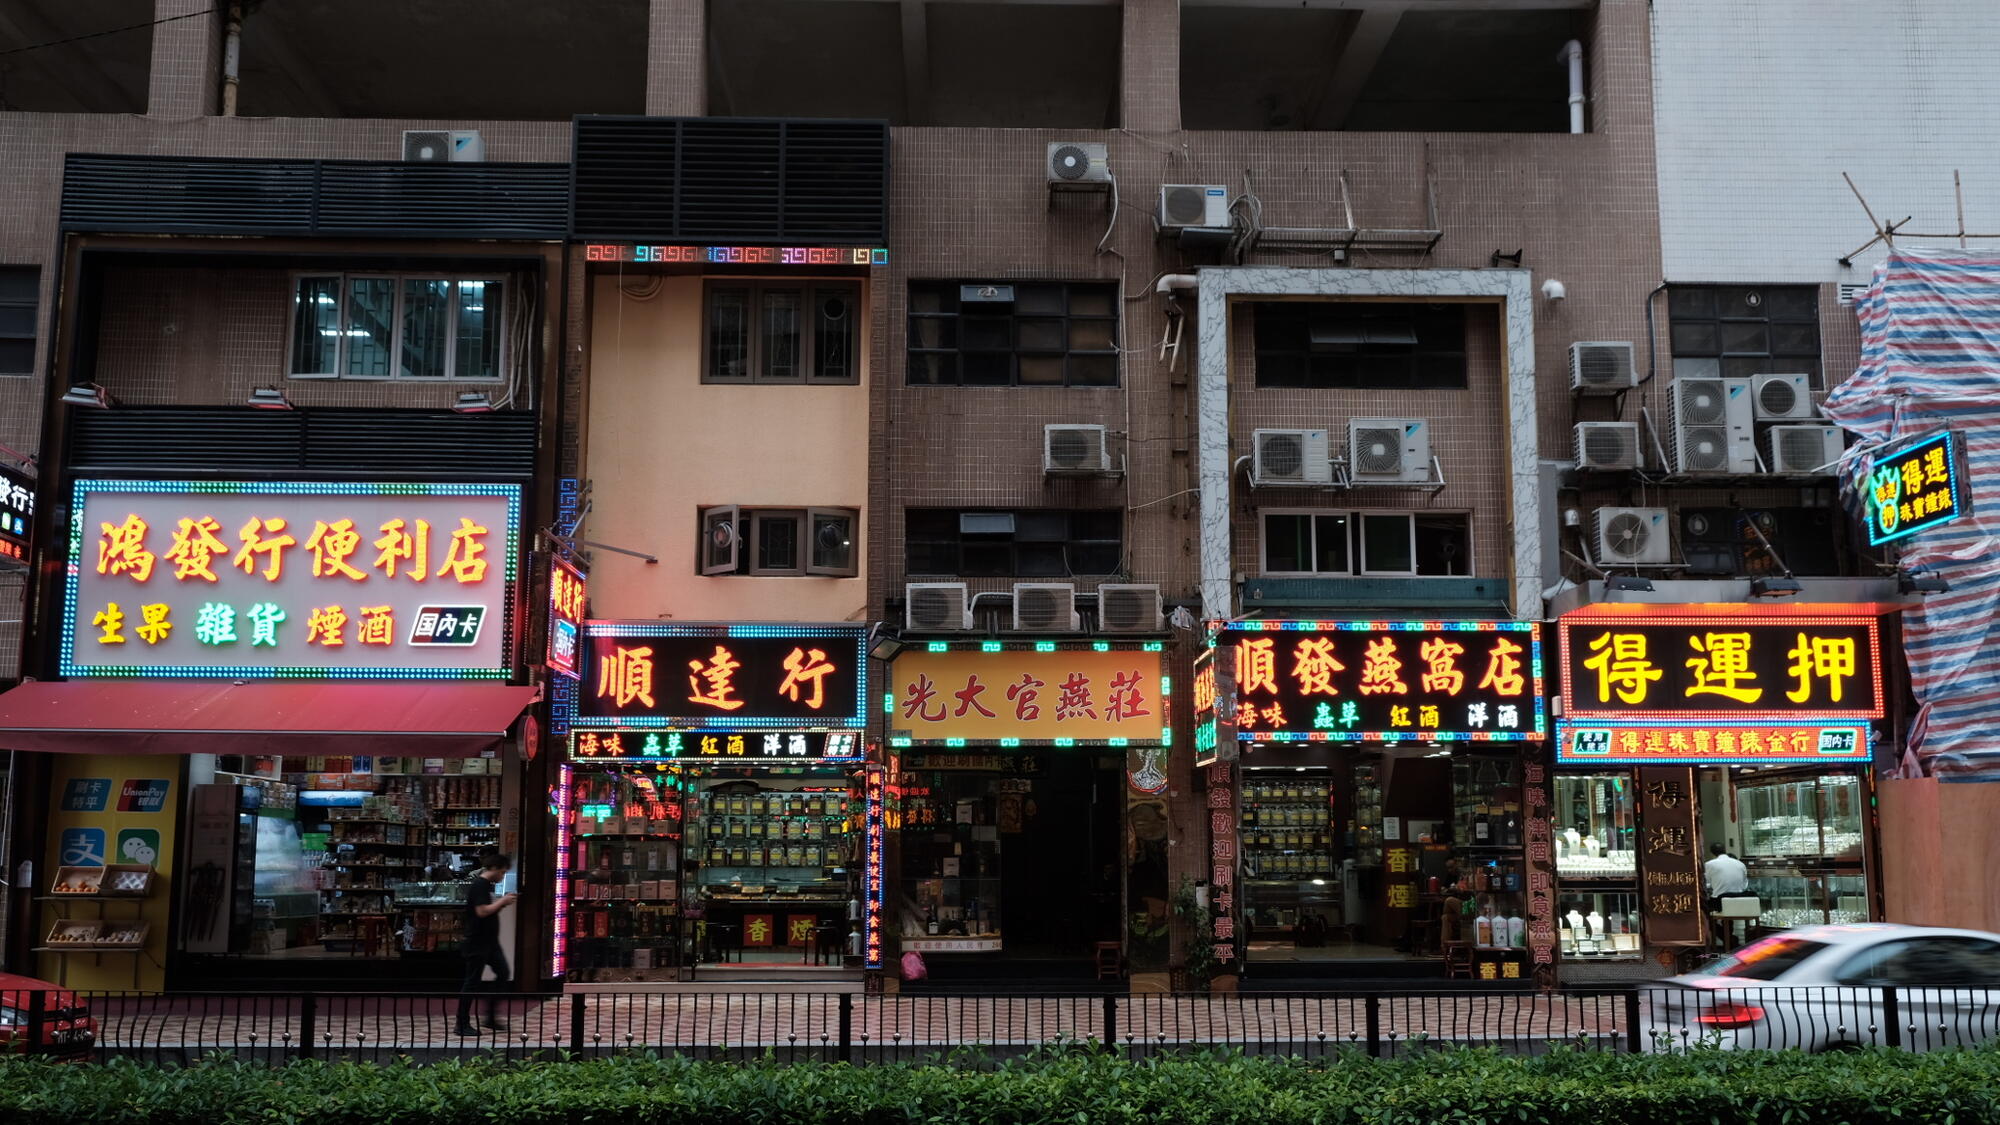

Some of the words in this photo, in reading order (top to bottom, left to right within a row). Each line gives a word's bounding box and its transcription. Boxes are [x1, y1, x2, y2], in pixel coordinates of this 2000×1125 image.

[1902, 447, 1948, 495] 得運
[95, 513, 489, 583] 鴻發行便利店
[92, 603, 174, 645] 生果
[195, 602, 286, 646] 雜貨
[306, 605, 393, 645] 煙酒
[597, 645, 836, 711] 順達行
[1235, 636, 1525, 696] 順發燕窩店
[1583, 631, 1855, 704] 得運押
[901, 670, 1151, 723] 光大官燕莊
[1236, 701, 1287, 729] 海味
[1390, 704, 1440, 729] 紅酒
[1467, 702, 1519, 729] 洋酒
[579, 733, 624, 756] 海味
[700, 735, 744, 755] 紅酒
[763, 733, 806, 756] 洋酒
[123, 786, 166, 799] UnionPay
[1524, 760, 1545, 807] 海味
[1528, 817, 1548, 862] 洋酒
[746, 917, 816, 943] 香煙
